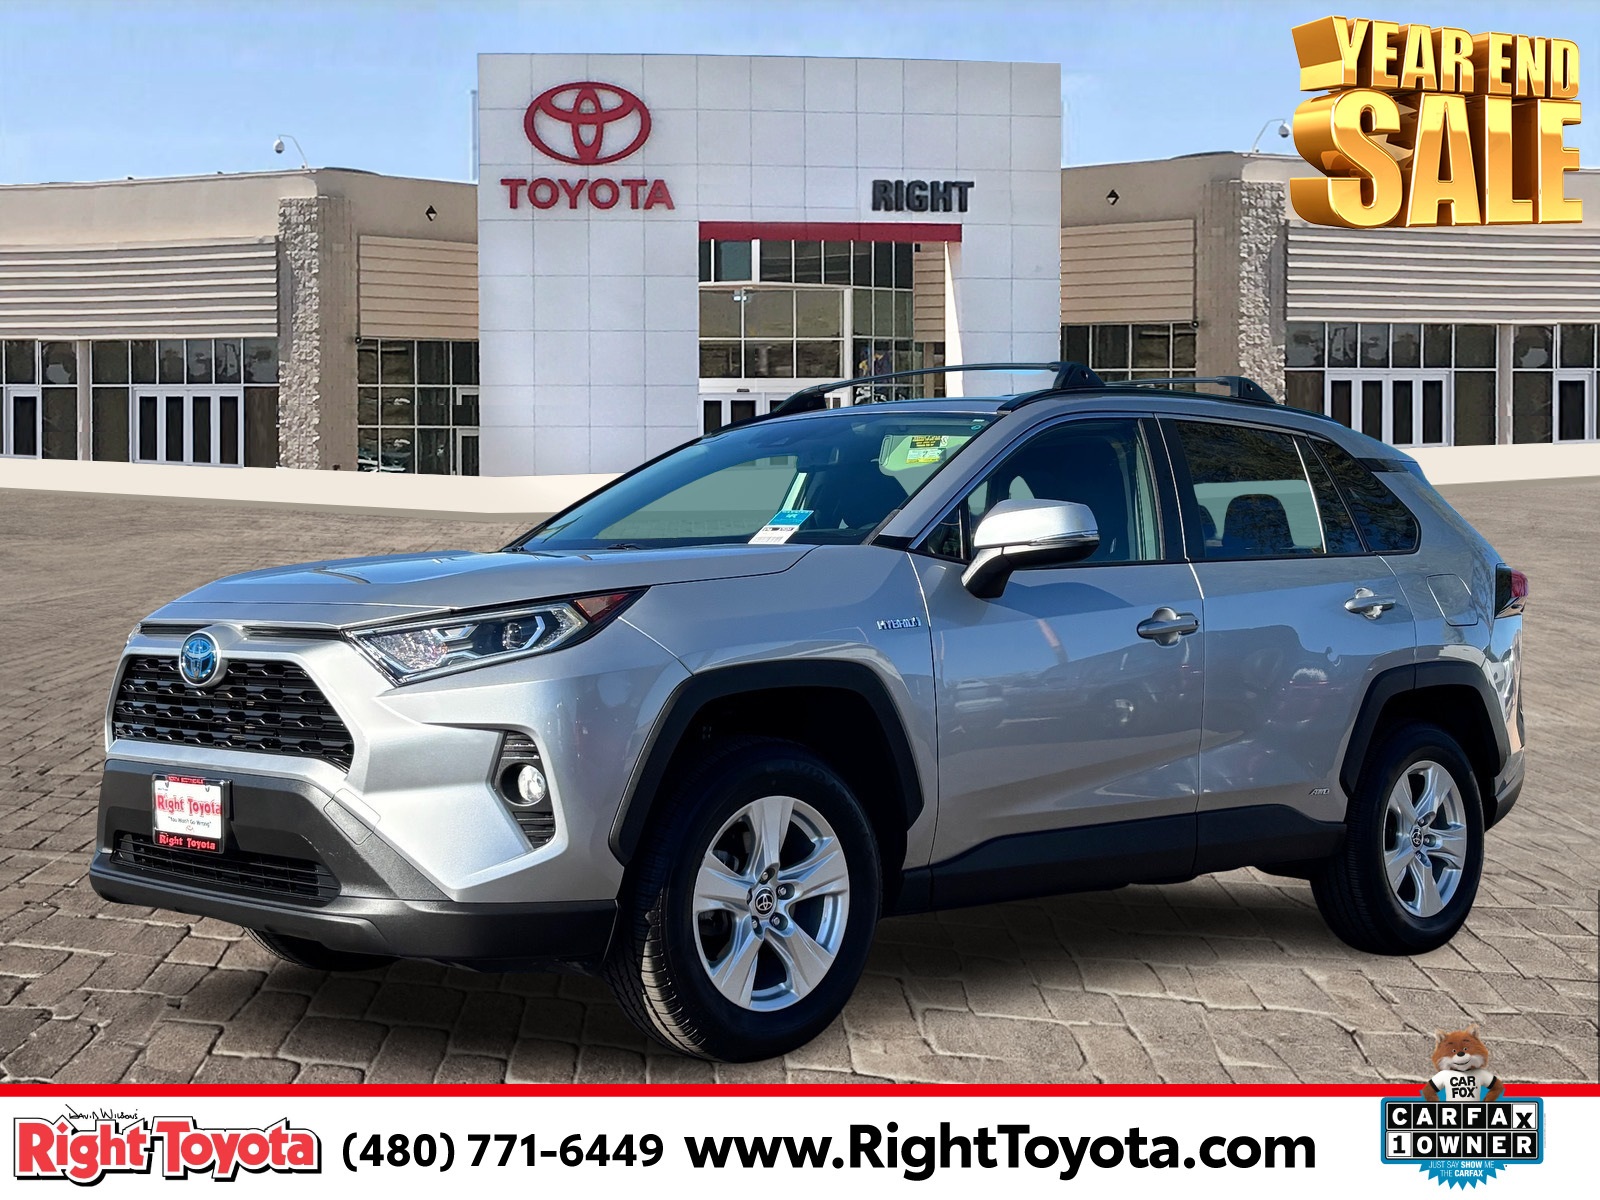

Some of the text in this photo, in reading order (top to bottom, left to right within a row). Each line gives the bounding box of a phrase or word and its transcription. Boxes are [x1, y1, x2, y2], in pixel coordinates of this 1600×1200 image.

[500, 178, 675, 210] TOYOTA
[872, 180, 975, 212] RIGHT
[876, 616, 921, 630] HYBRID
[156, 793, 223, 816] Right Toyota
[159, 833, 216, 850] Right Toyota
